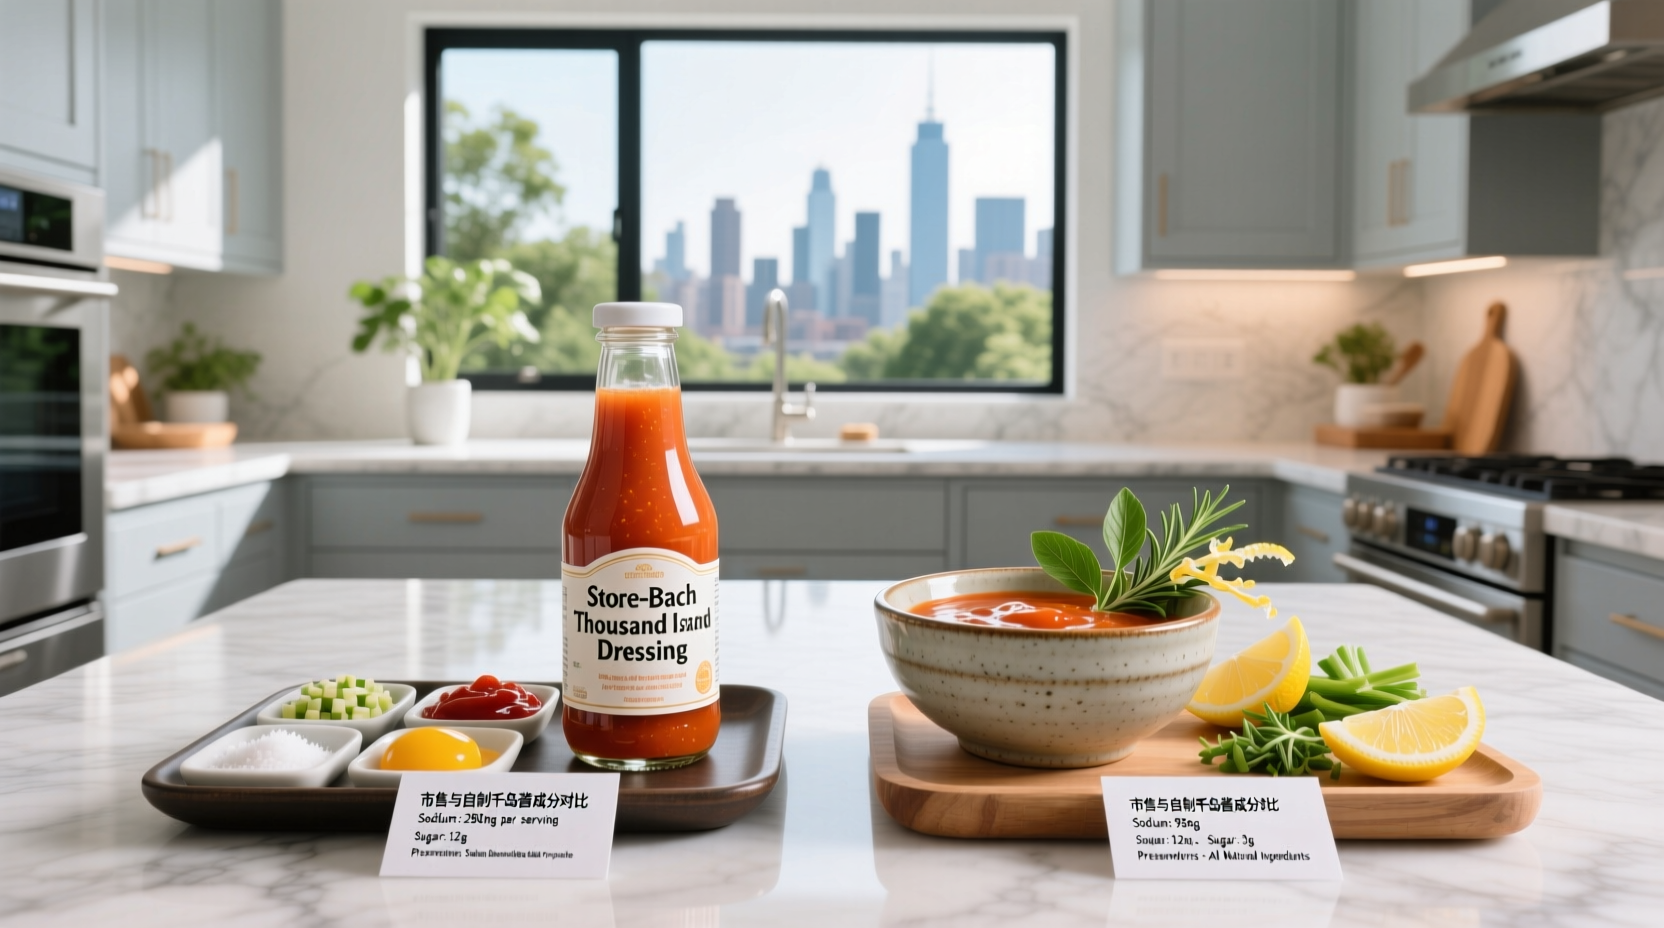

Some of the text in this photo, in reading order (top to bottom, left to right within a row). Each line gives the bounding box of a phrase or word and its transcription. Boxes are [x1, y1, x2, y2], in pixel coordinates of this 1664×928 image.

[588, 584, 696, 608] Store-Bach
[574, 610, 666, 635] Thousand
[598, 639, 687, 664] Dressing
[501, 816, 516, 826] per
[450, 832, 467, 844] 12g
